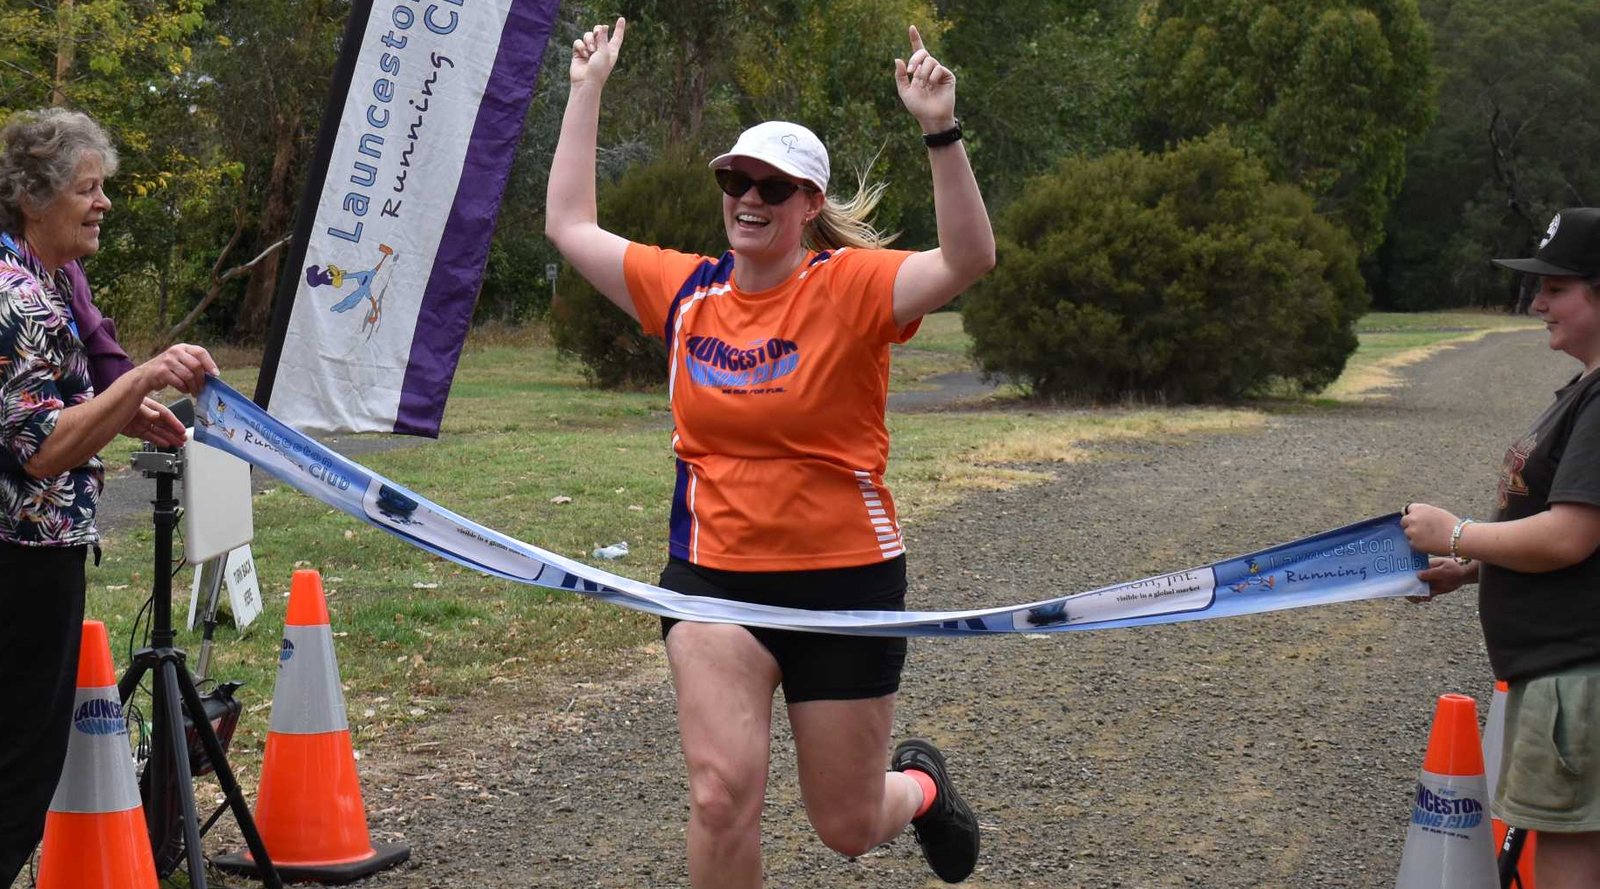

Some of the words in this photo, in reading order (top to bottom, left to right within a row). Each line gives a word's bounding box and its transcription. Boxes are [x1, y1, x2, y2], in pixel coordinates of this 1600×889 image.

[327, 0, 421, 243] Launcesto
[380, 52, 455, 218] Running
[308, 462, 351, 492] Club
[1285, 566, 1367, 583] Running
[1374, 551, 1422, 574] Club
